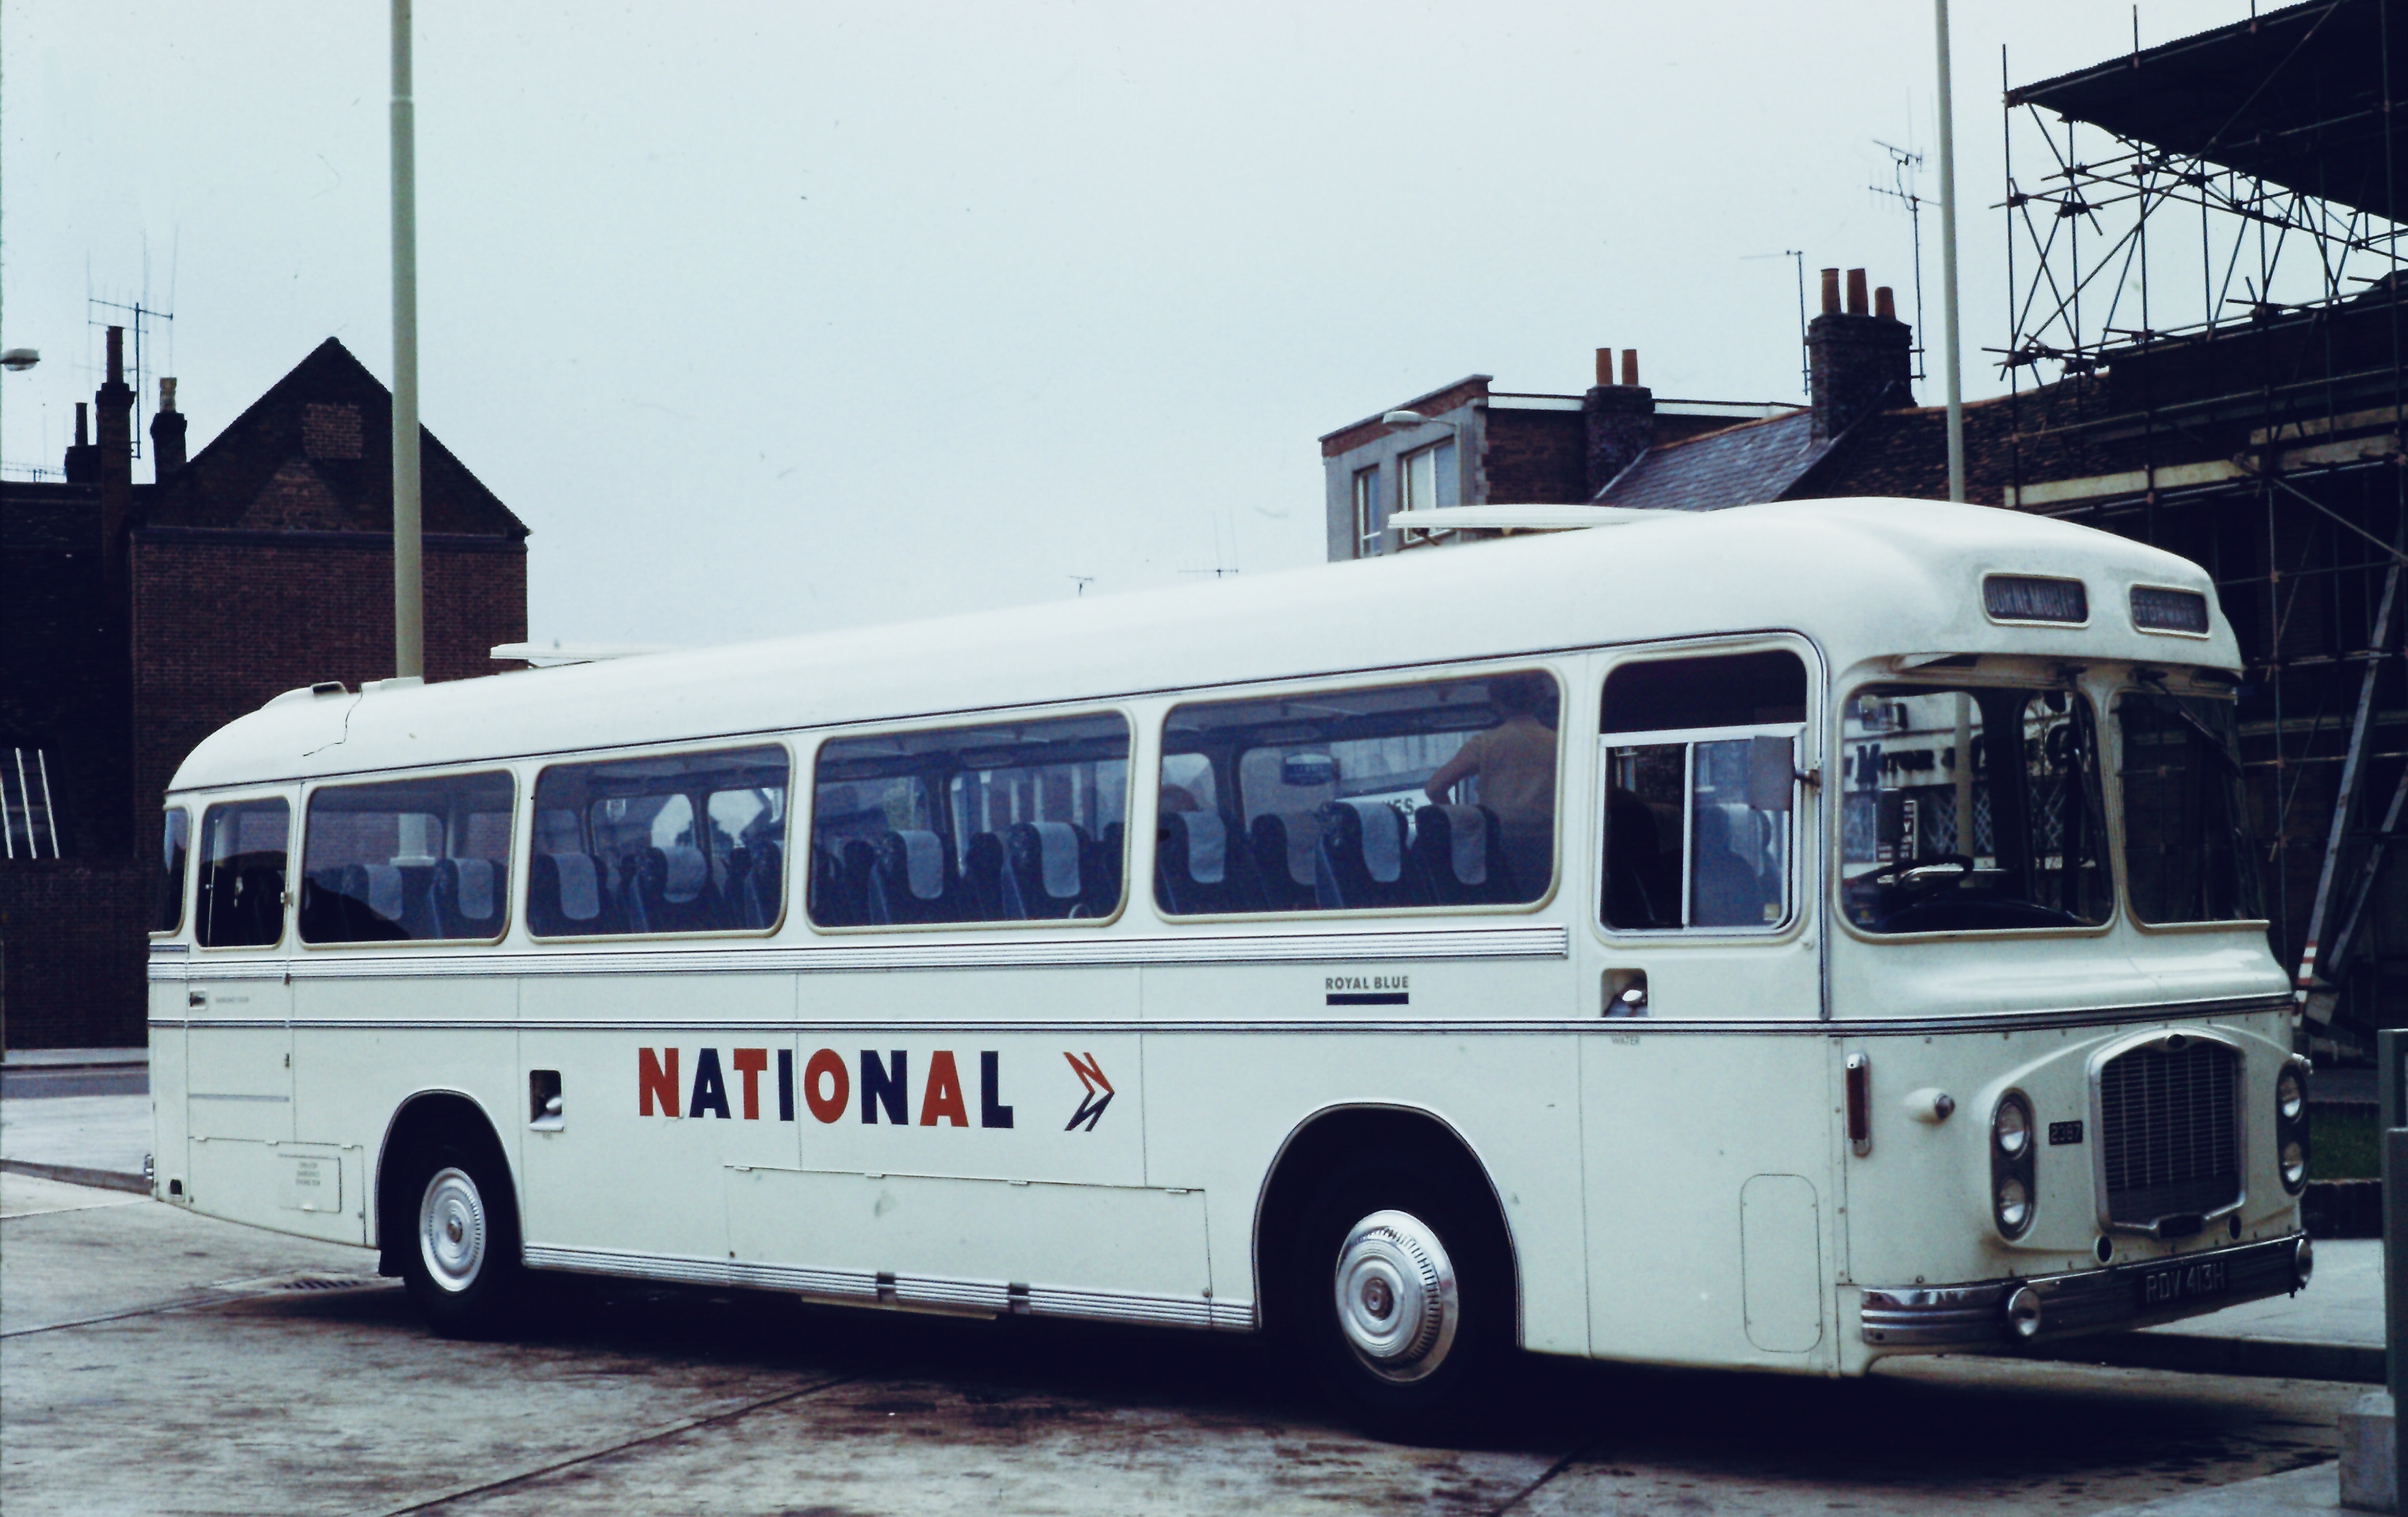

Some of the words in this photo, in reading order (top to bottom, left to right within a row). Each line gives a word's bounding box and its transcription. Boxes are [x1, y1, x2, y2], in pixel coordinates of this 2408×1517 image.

[1326, 977, 1369, 989] ROYAL
[1375, 976, 1408, 989] BLUE
[1611, 1034, 1641, 1045] WATER
[639, 1048, 1014, 1129] NATIONAL
[2147, 1270, 2181, 1304] RDV
[2187, 1262, 2225, 1293] 413H
